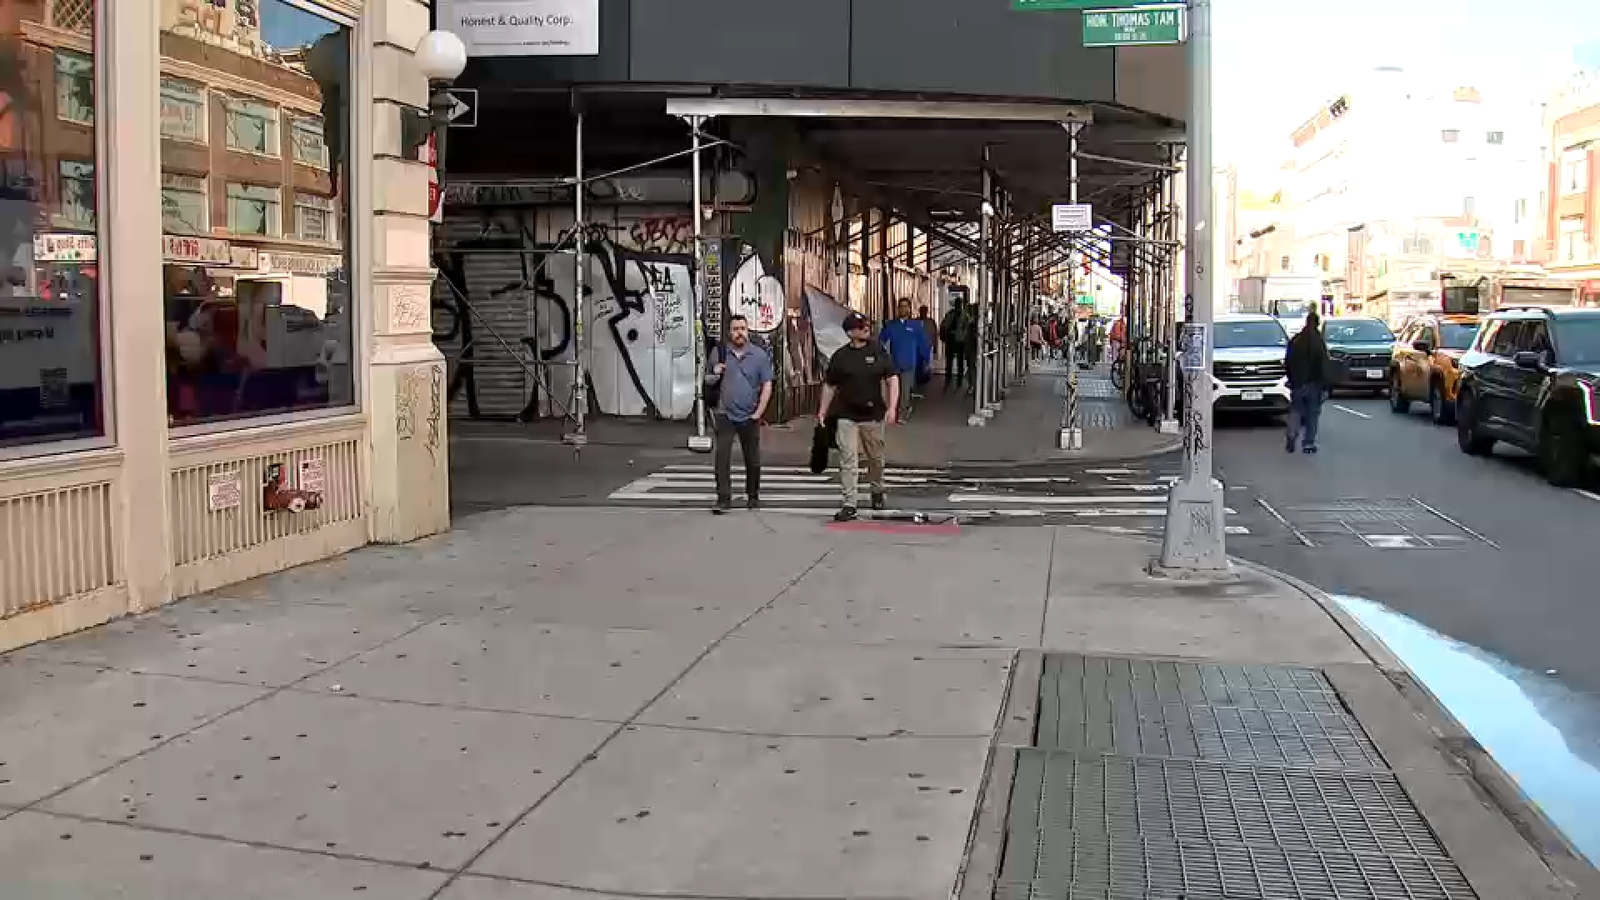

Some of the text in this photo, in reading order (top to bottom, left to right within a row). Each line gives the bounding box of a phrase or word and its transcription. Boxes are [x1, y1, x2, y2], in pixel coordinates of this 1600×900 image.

[461, 14, 573, 27] Honest & Quality Corp.
[1112, 12, 1150, 27] THOMAS
[1154, 11, 1174, 26] TAM
